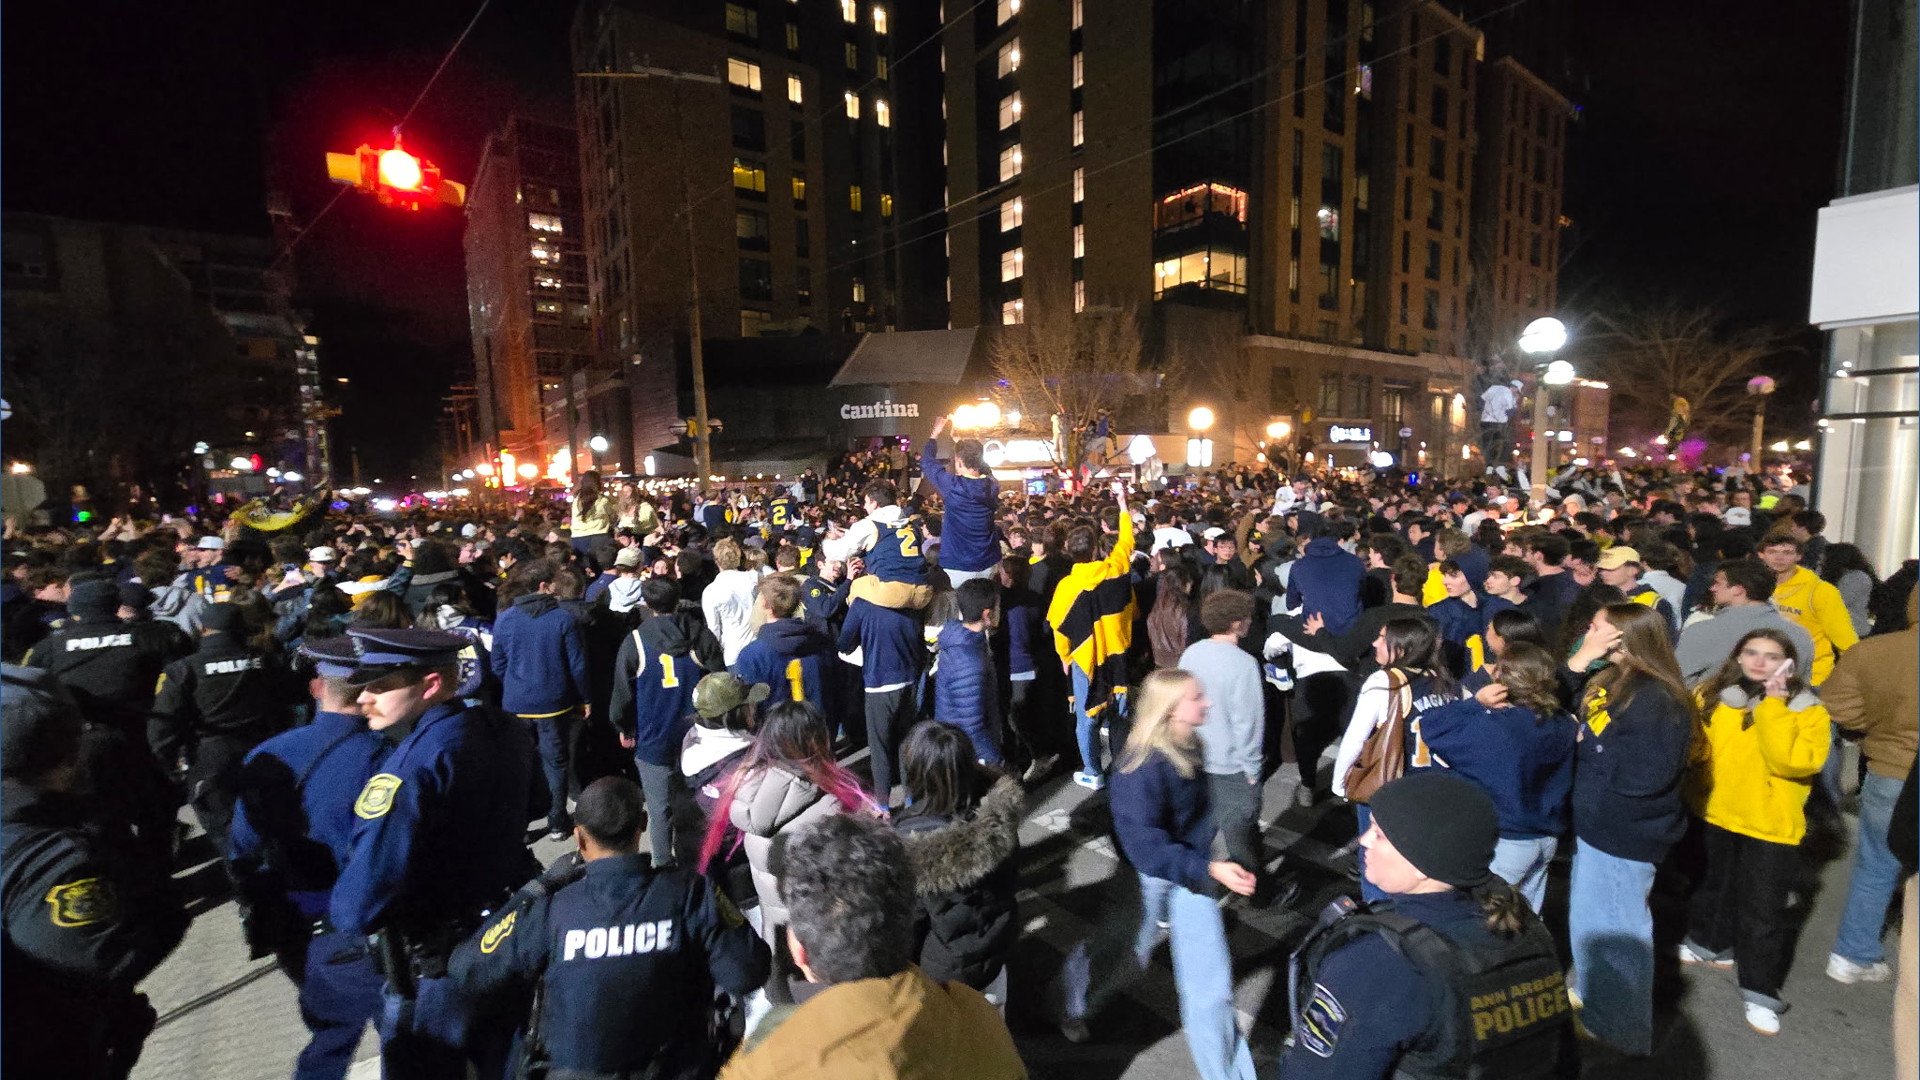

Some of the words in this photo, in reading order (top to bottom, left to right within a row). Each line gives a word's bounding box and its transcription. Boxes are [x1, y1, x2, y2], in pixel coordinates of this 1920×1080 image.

[840, 399, 919, 419] cantina
[772, 505, 787, 525] 2
[895, 528, 919, 557] 2
[65, 633, 133, 651] POLICE
[205, 657, 262, 675] POLICE
[658, 652, 680, 688] 1
[785, 658, 805, 702] 1
[563, 919, 673, 962] POLICE
[1470, 990, 1507, 1010] ANN
[1472, 985, 1569, 1040] POLICE
